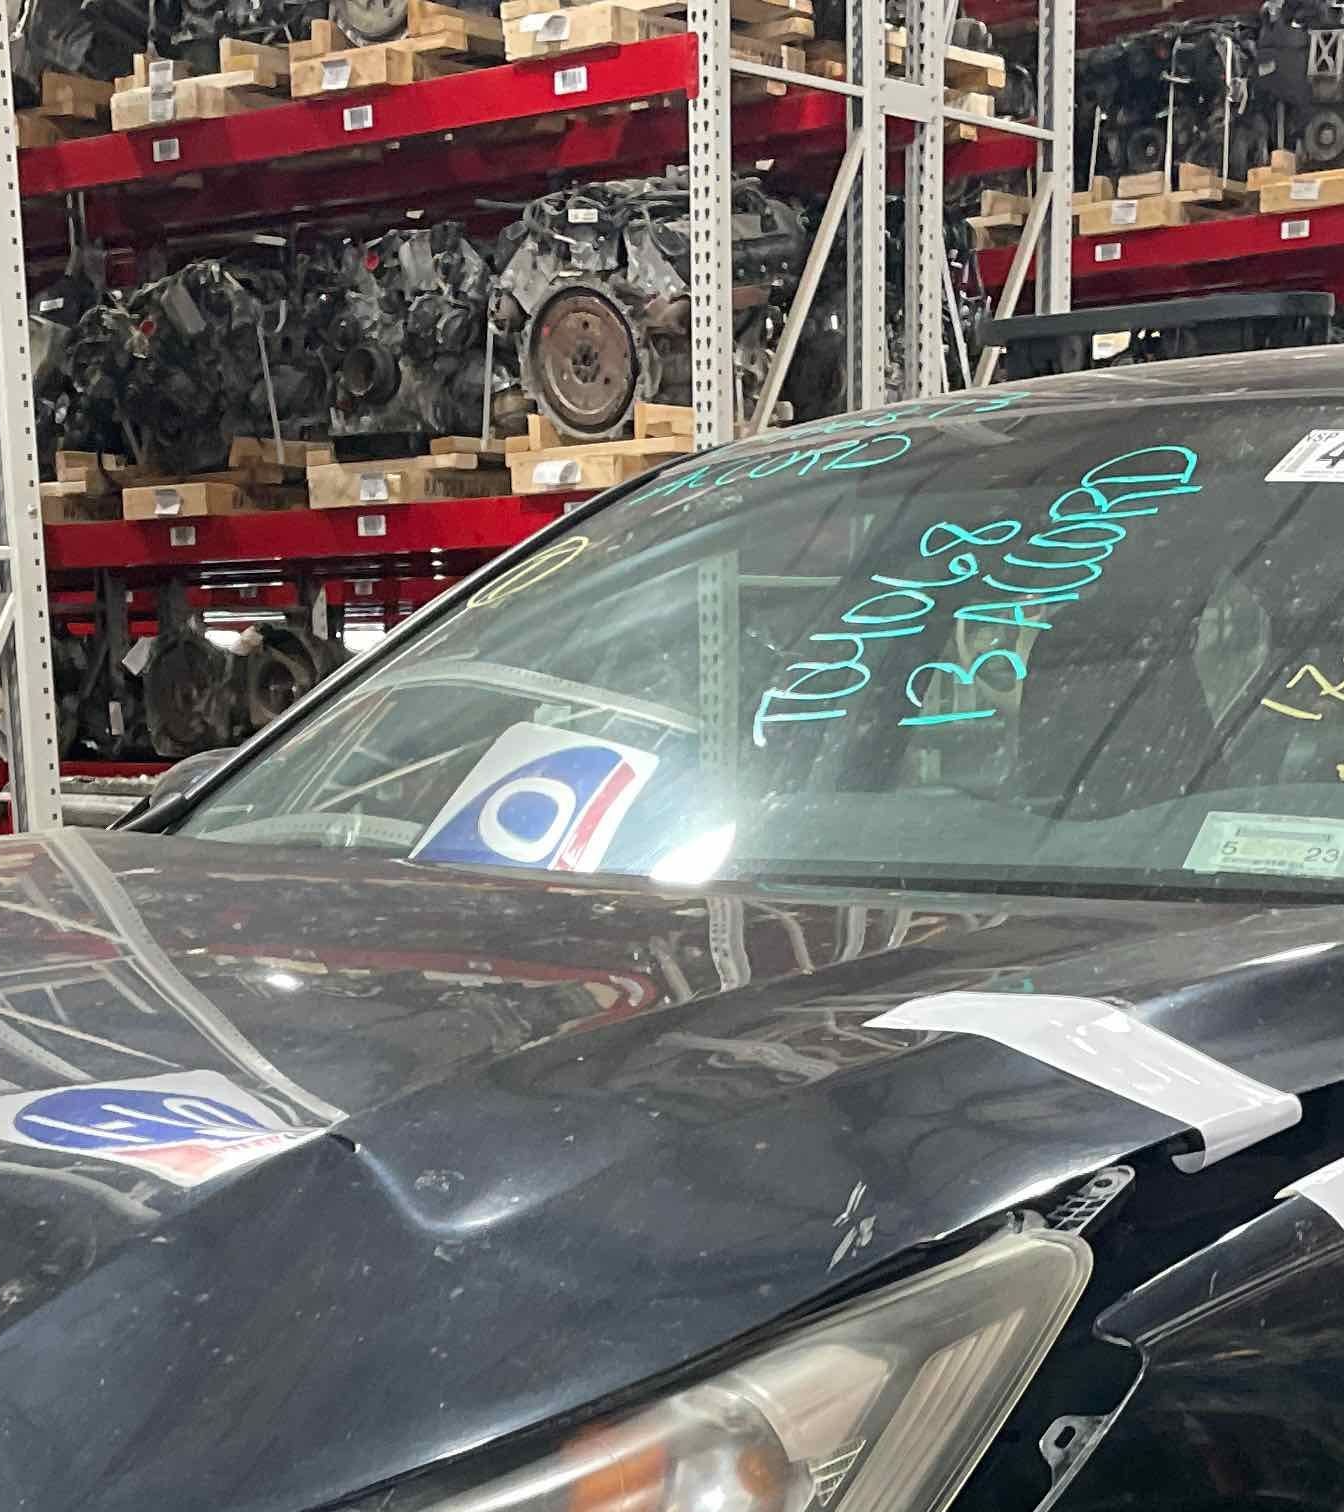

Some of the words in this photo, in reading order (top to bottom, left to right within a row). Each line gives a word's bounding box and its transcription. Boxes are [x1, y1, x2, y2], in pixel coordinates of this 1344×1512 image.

[953, 445, 1203, 631] ACCORD
[897, 649, 1028, 727] 13
[1305, 846, 1341, 864] 23
